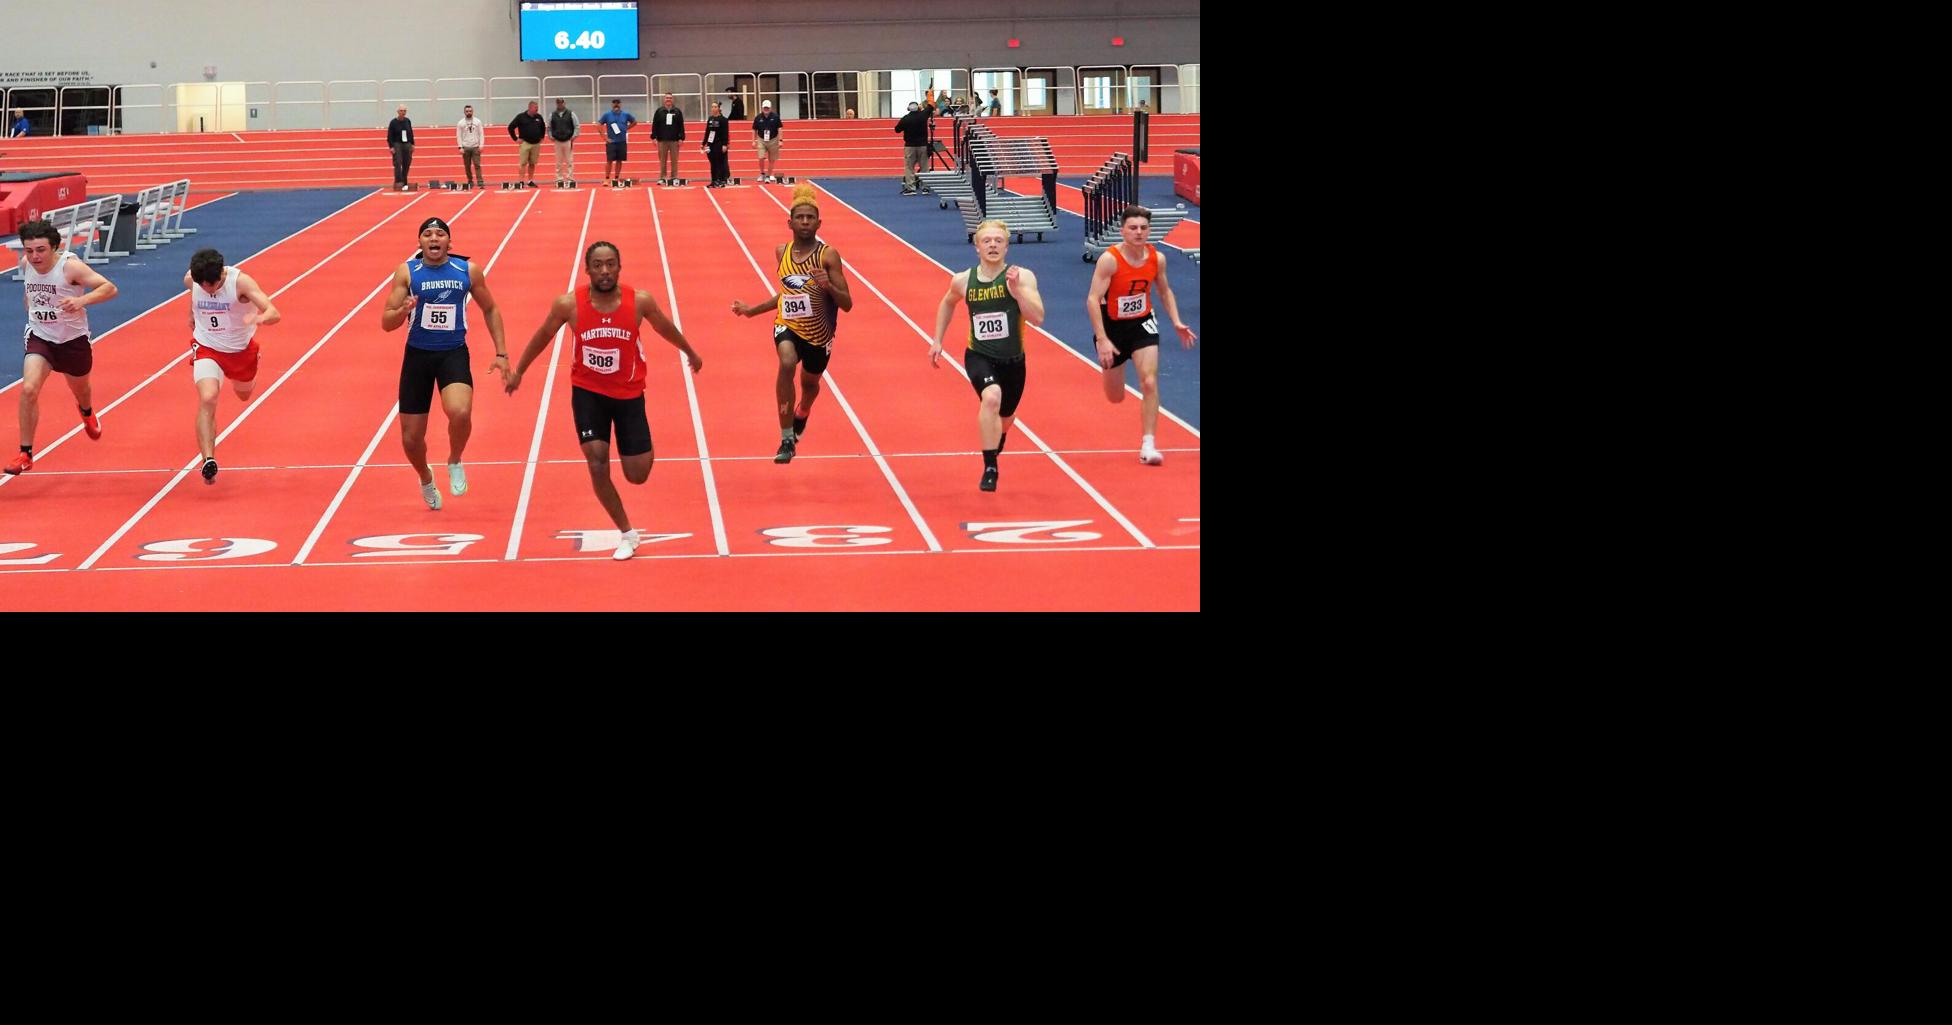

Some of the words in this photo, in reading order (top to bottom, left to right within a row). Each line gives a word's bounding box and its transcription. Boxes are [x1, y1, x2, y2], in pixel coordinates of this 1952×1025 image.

[554, 30, 605, 50] 6.40
[421, 280, 463, 291] BRUNSWICK
[968, 285, 1006, 302] GLENVAR
[784, 300, 806, 314] 394
[1123, 299, 1143, 313] 233
[35, 310, 57, 321] 376
[210, 316, 219, 328] 9
[431, 311, 447, 324] 55
[581, 327, 632, 341] MARTINSVILLE
[979, 319, 1003, 334] 203
[588, 353, 613, 368] 308
[757, 525, 894, 548] 3
[964, 519, 1103, 543] 2
[136, 537, 278, 561] 6
[350, 533, 486, 557] 5
